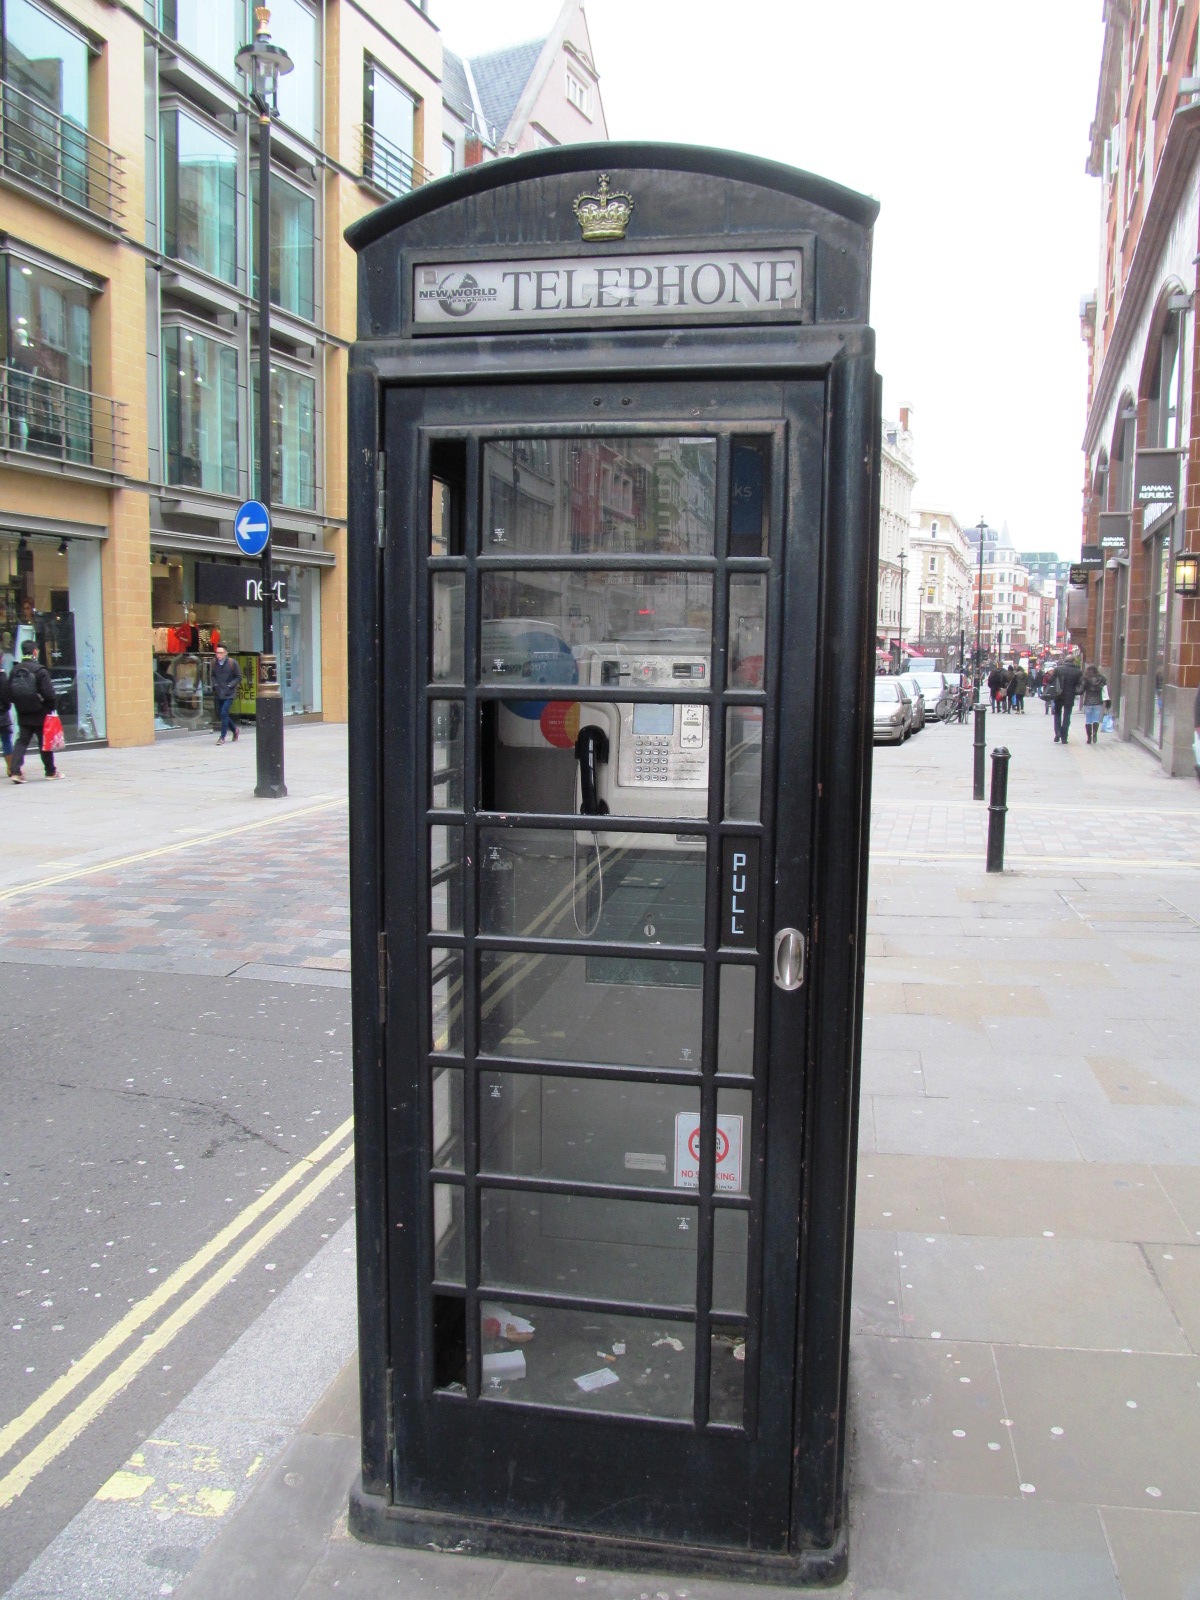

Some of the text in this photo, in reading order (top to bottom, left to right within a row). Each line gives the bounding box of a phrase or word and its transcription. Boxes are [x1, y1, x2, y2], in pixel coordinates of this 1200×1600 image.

[419, 287, 497, 298] NEW WORLD
[502, 260, 797, 311] TELEPHONE
[731, 853, 747, 934] PULL
[682, 1170, 737, 1182] NO SKING.
